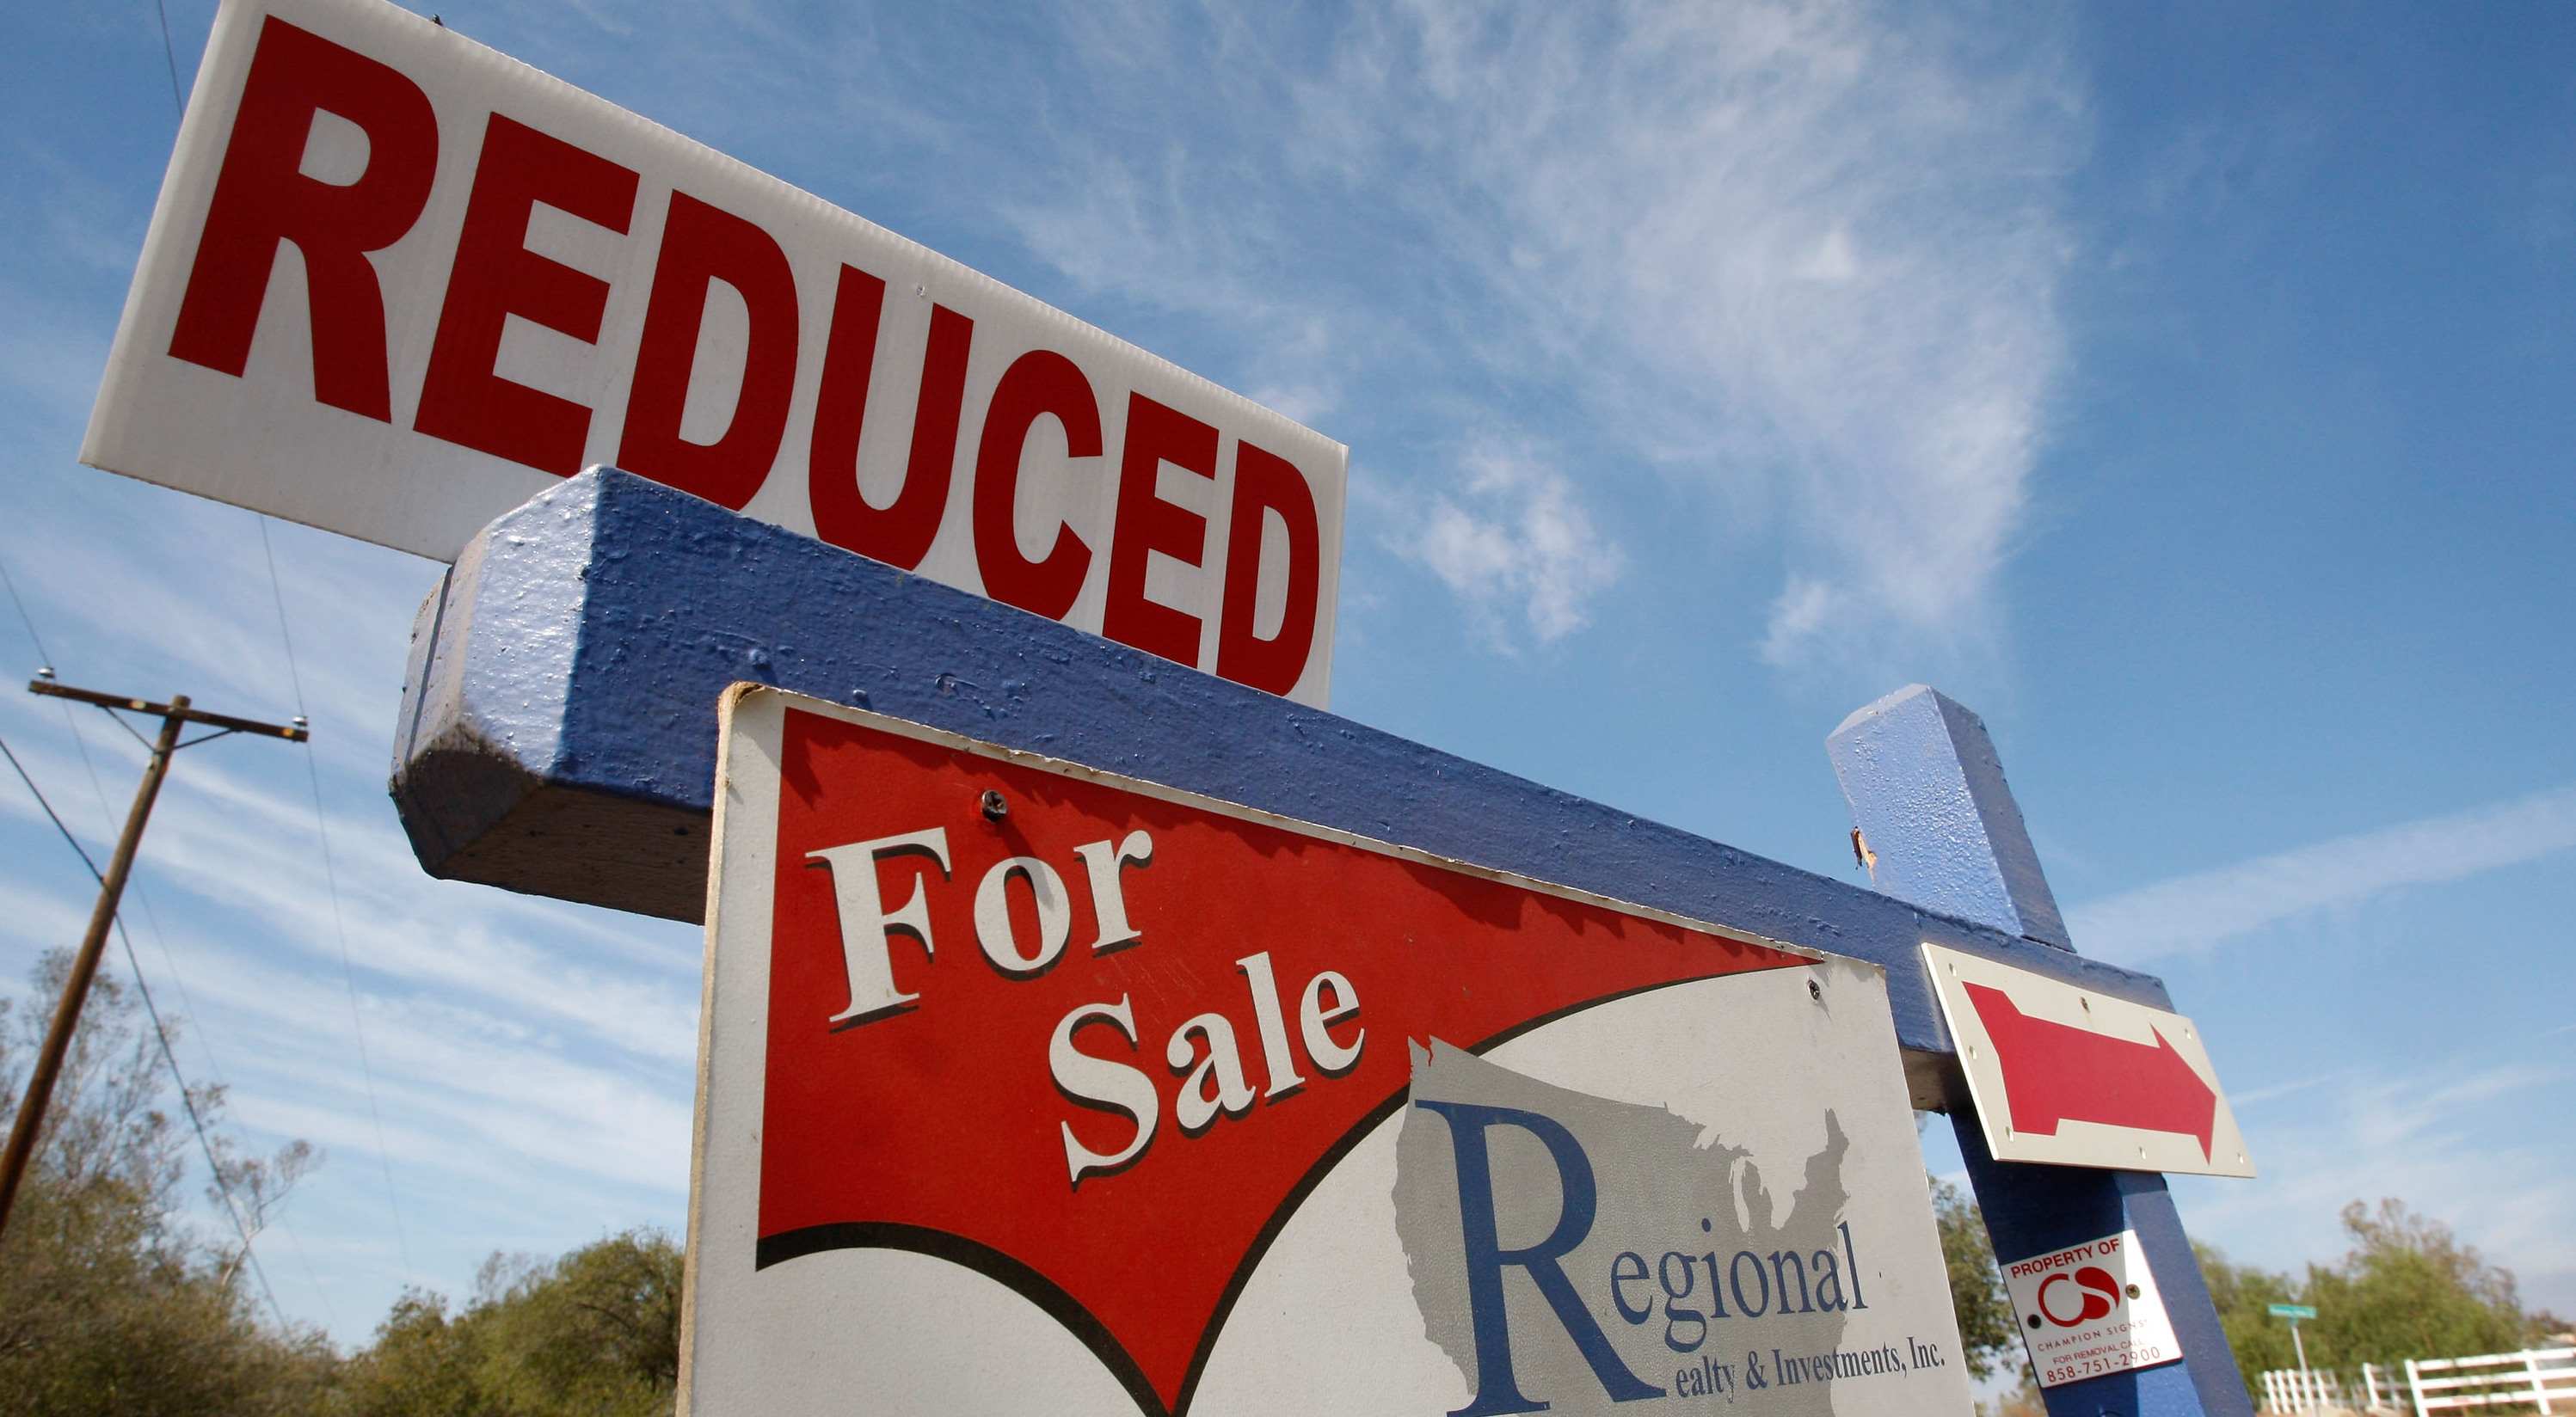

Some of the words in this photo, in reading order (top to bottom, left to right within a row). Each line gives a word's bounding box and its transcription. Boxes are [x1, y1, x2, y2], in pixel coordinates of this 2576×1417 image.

[168, 14, 1320, 698] REDUCED
[805, 826, 1153, 1032] For
[1048, 951, 1366, 1192] Sale
[1415, 1099, 1868, 1417] Regional
[2010, 1246, 2093, 1279] PROPERTY
[2098, 1238, 2120, 1256] OF
[1746, 1350, 1768, 1390] &
[1771, 1341, 1907, 1386] Investments,
[1906, 1335, 1945, 1369] Inc.
[2037, 1330, 2102, 1352] CHAMPION
[2046, 1346, 2161, 1383] 858-751-2900
[2052, 1354, 2073, 1365] FOR
[2074, 1344, 2119, 1360] REMOVAL
[2120, 1337, 2145, 1350] CALL
